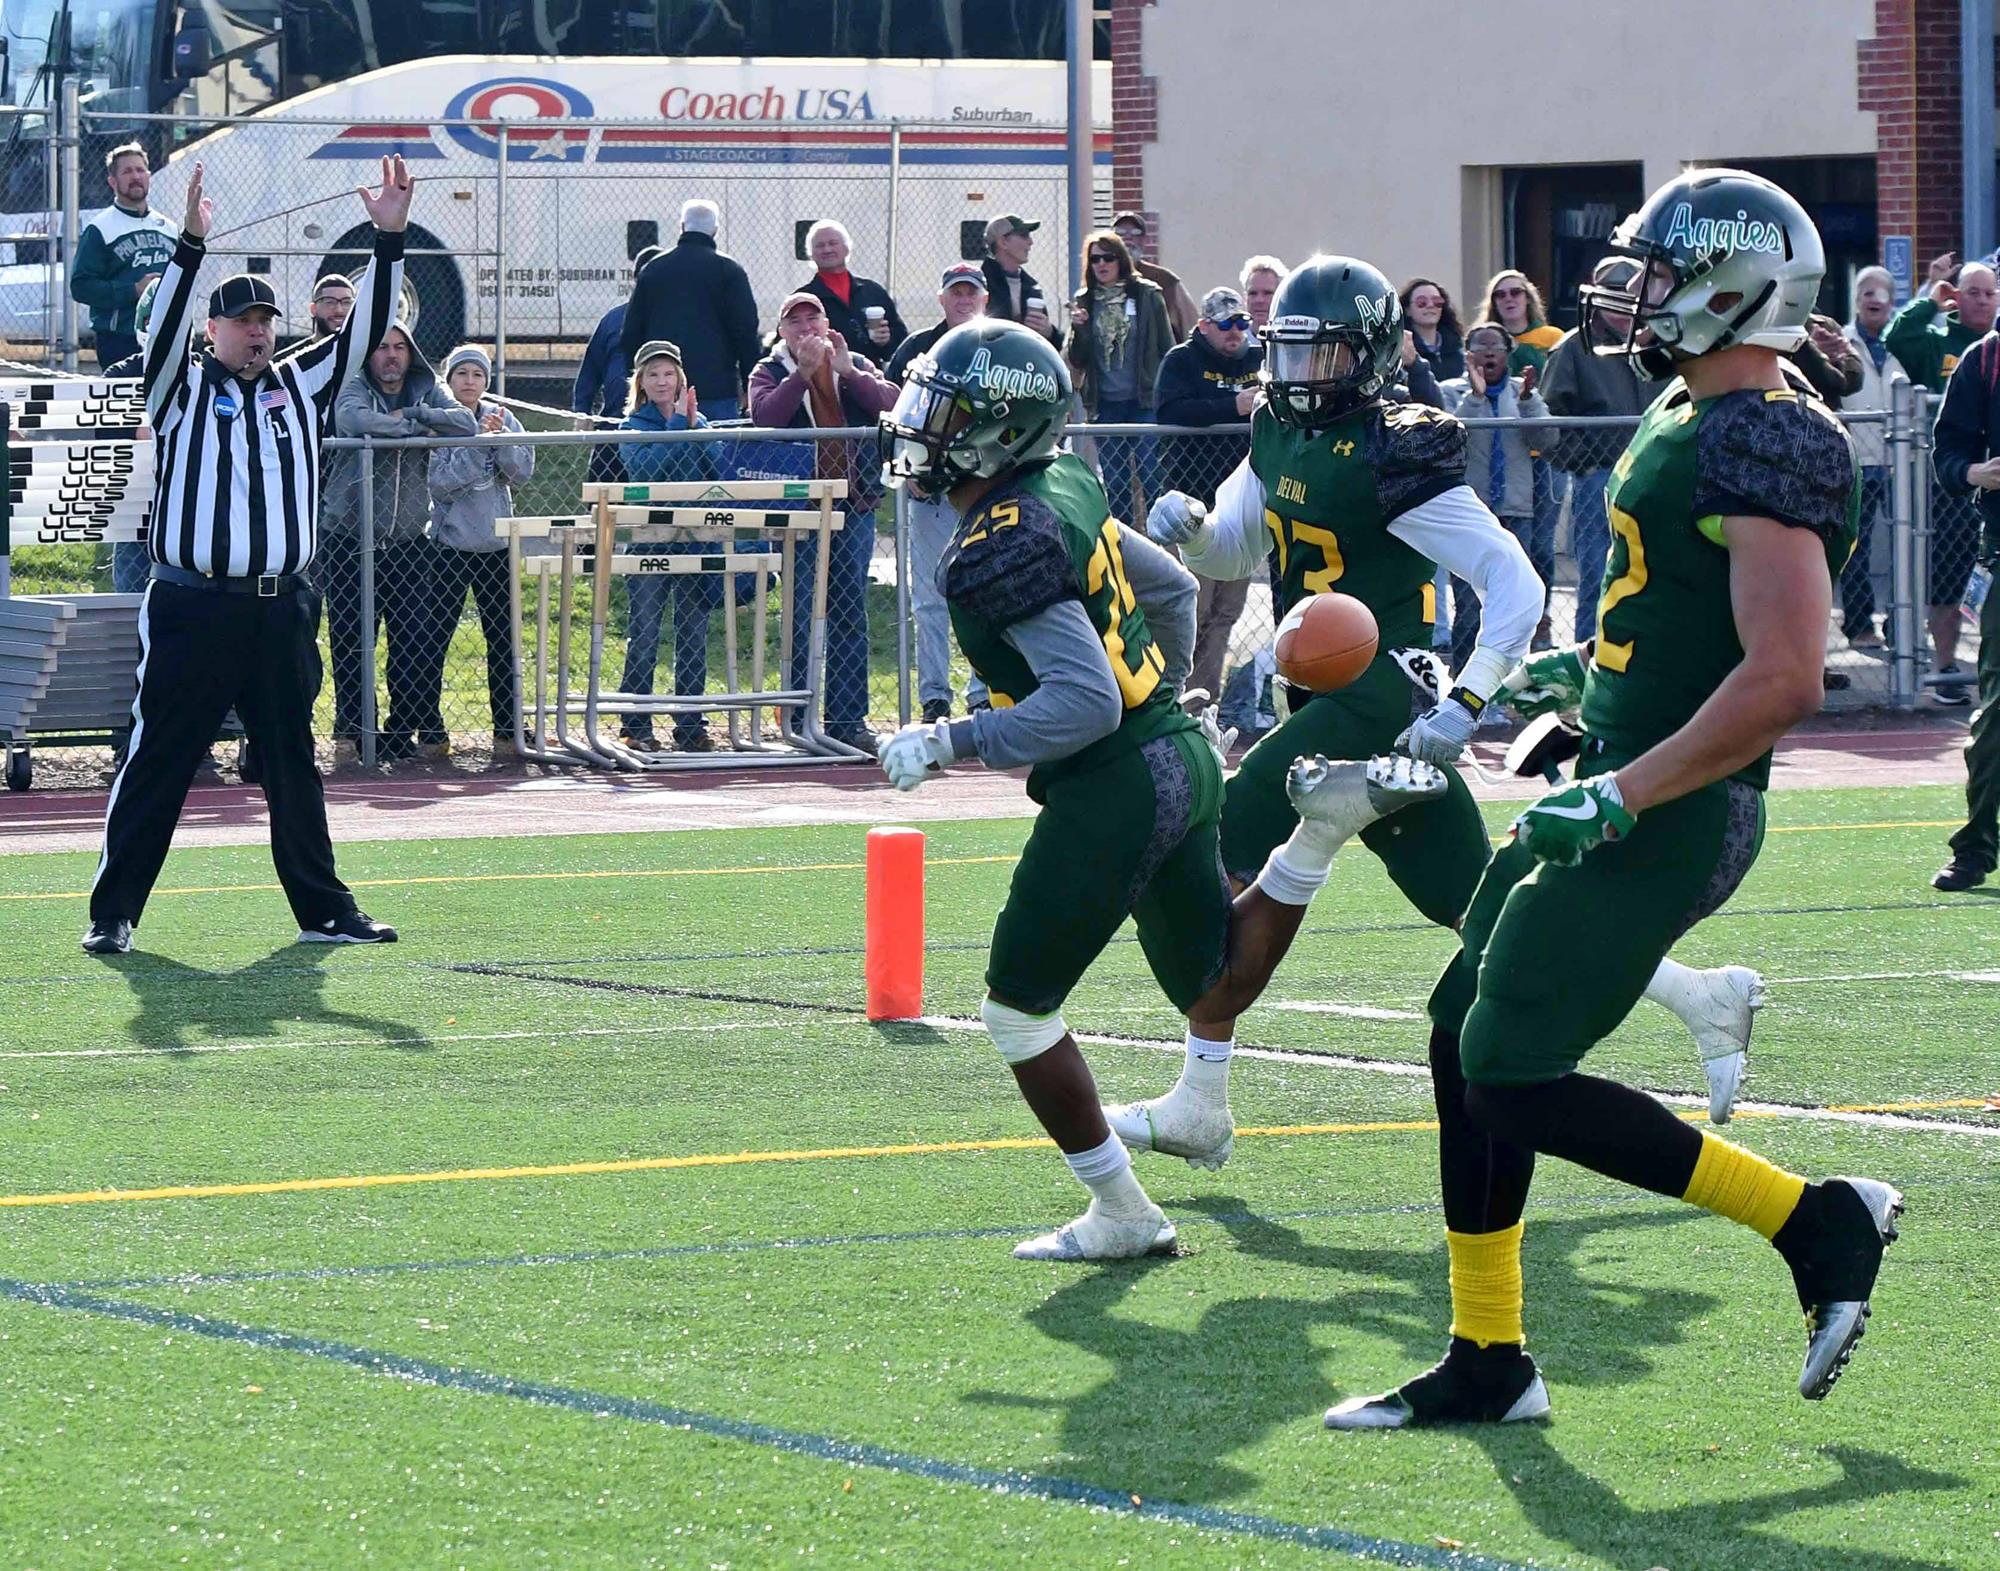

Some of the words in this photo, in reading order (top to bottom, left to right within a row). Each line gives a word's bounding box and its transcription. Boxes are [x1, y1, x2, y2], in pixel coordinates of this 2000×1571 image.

[660, 86, 786, 121] Coach
[796, 88, 876, 121] USA
[951, 106, 1033, 122] Suburban
[674, 150, 768, 162] STAGECOACH
[1664, 202, 1784, 263] Aggies
[480, 269, 533, 281] OPATED
[559, 269, 615, 281] SUBURBAN
[480, 285, 513, 298] UST
[962, 347, 1058, 404] Aggies
[76, 414, 142, 426] UCS
[68, 445, 133, 461] UCS
[68, 461, 133, 475] UCS
[62, 475, 128, 488] UCS
[59, 488, 125, 501] UCS
[1276, 475, 1307, 505] DELVAL
[49, 502, 115, 515] UCS
[43, 516, 109, 529] UCS
[38, 529, 103, 543] UCS
